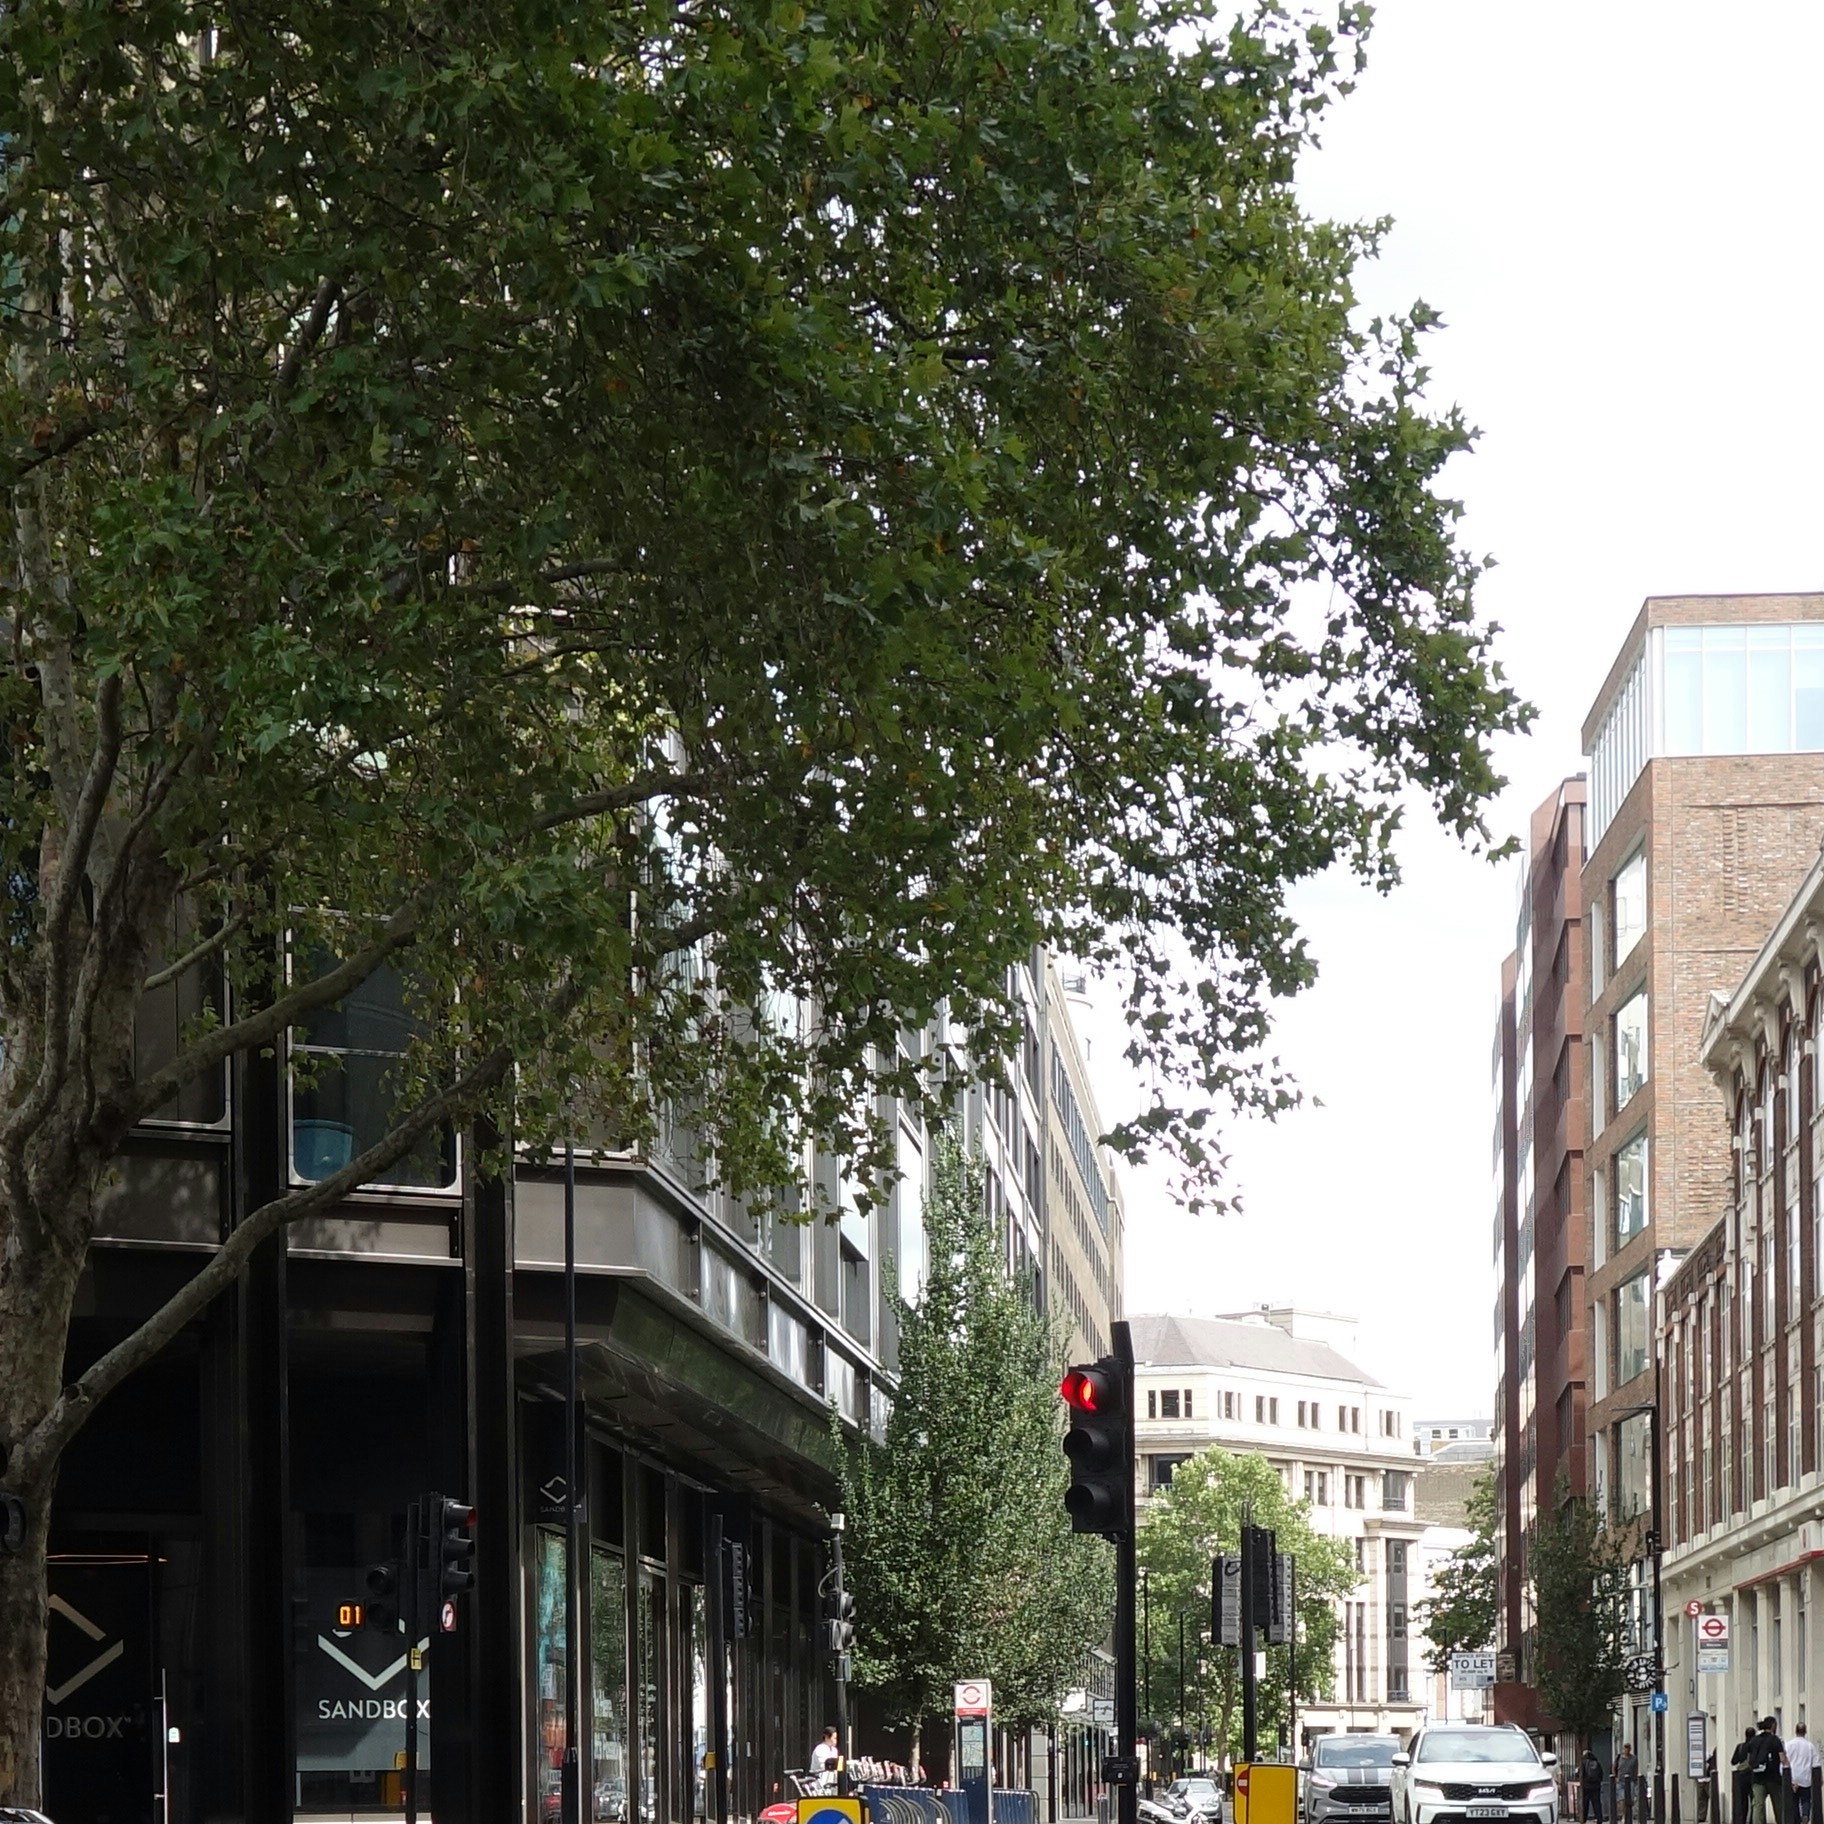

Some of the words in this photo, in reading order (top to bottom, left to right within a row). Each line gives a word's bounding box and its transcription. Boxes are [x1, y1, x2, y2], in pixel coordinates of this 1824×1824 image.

[1690, 1602, 1699, 1614] S
[339, 1605, 361, 1625] 01
[1454, 1659, 1470, 1669] TO
[1473, 1659, 1494, 1669] LET
